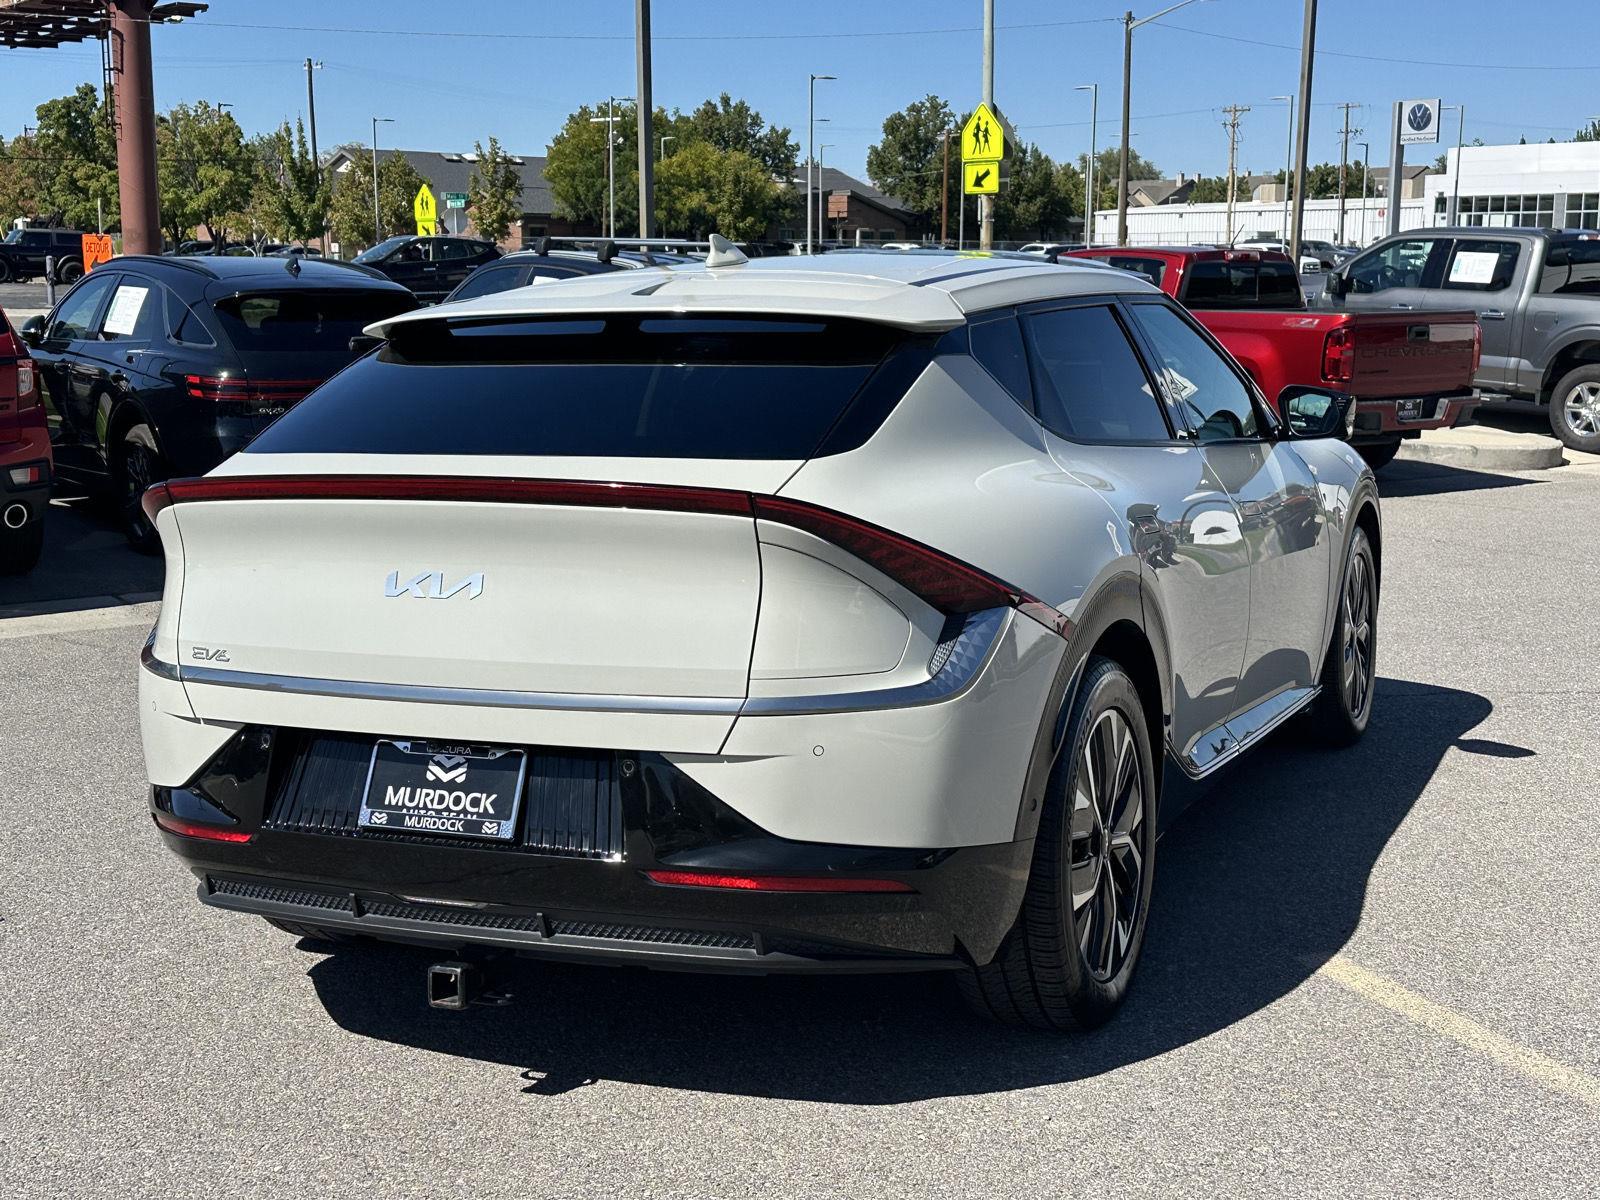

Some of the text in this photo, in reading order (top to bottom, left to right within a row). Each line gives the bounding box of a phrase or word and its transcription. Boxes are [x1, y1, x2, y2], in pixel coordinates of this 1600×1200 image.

[85, 242, 110, 254] DETOUR
[384, 568, 486, 601] KIA
[192, 646, 231, 662] EV6
[436, 744, 472, 755] CURA
[384, 785, 498, 815] MURDOCK
[404, 815, 465, 832] MURDOCK
